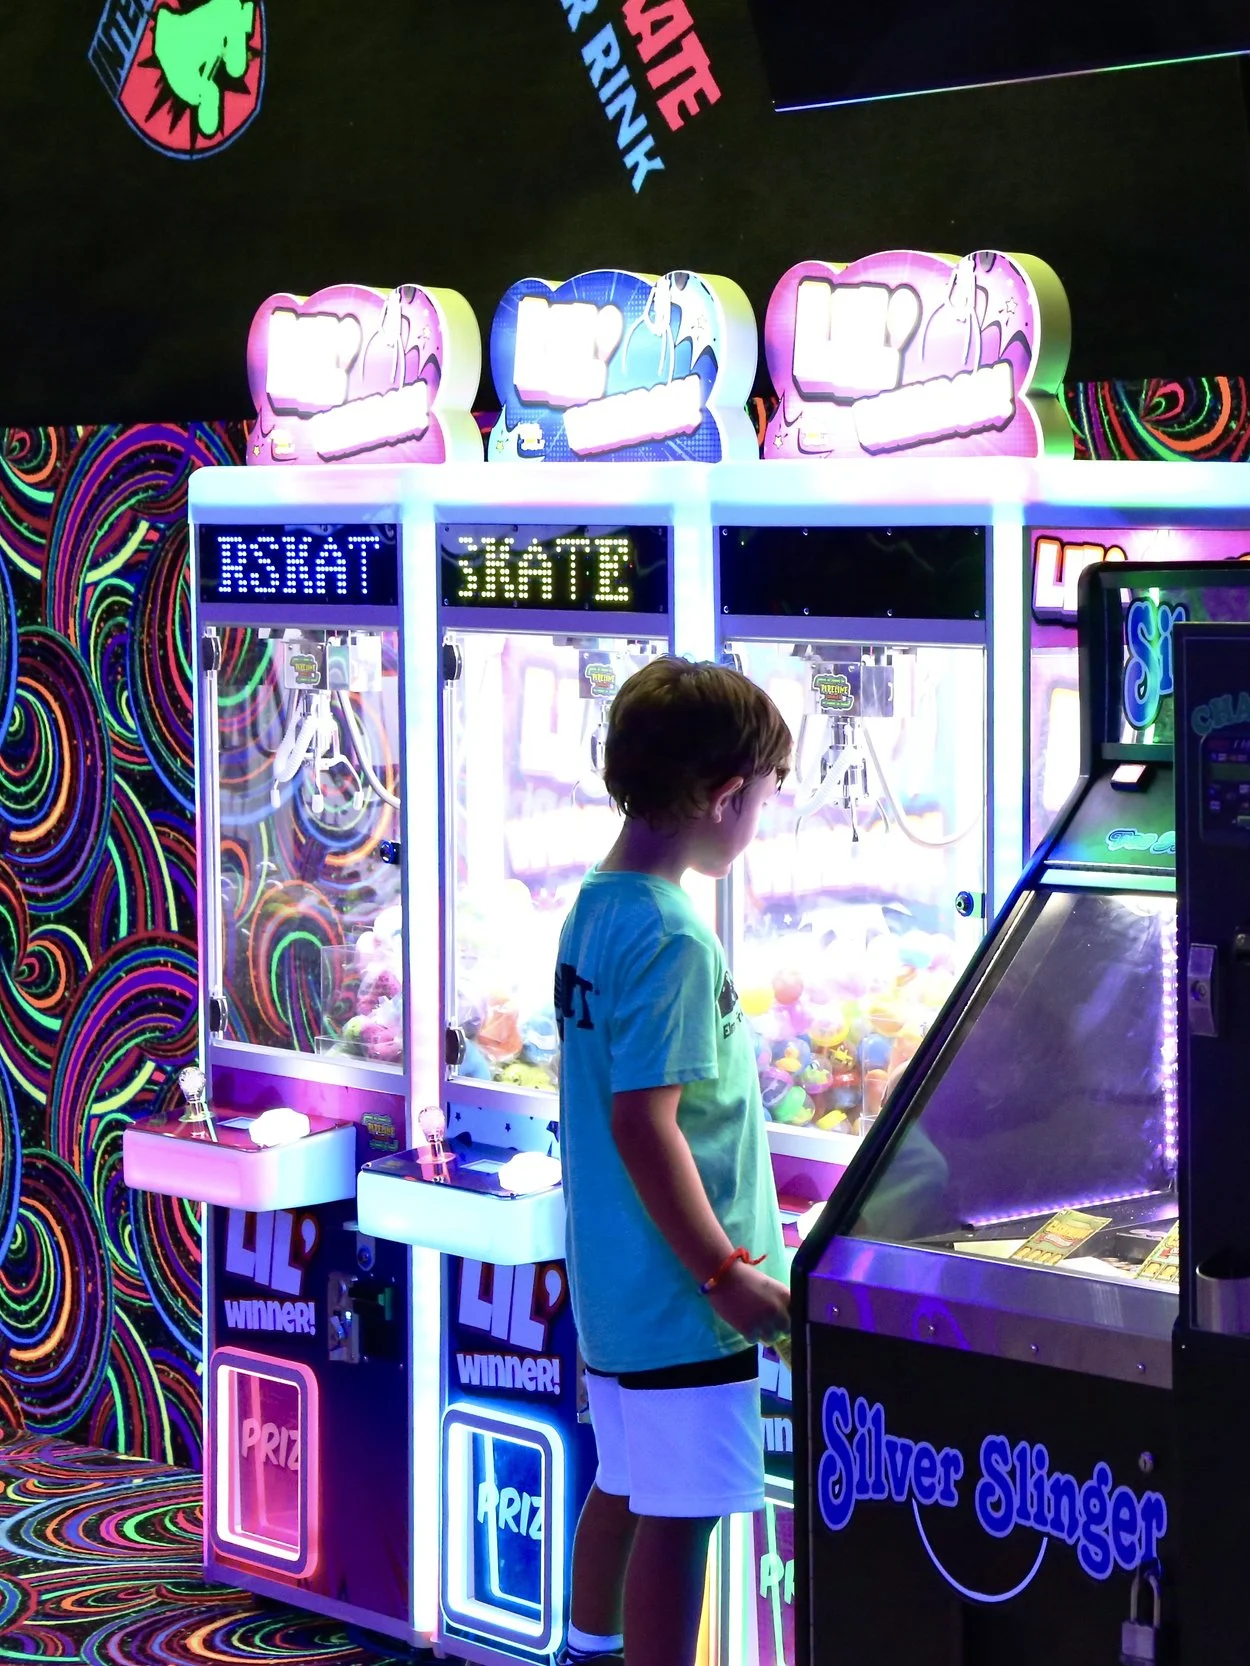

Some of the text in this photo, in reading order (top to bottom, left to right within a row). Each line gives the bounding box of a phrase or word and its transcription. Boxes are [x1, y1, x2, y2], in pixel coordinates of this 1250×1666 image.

[581, 22, 665, 194] RINK
[818, 1385, 1168, 1581] Silver Slinger
